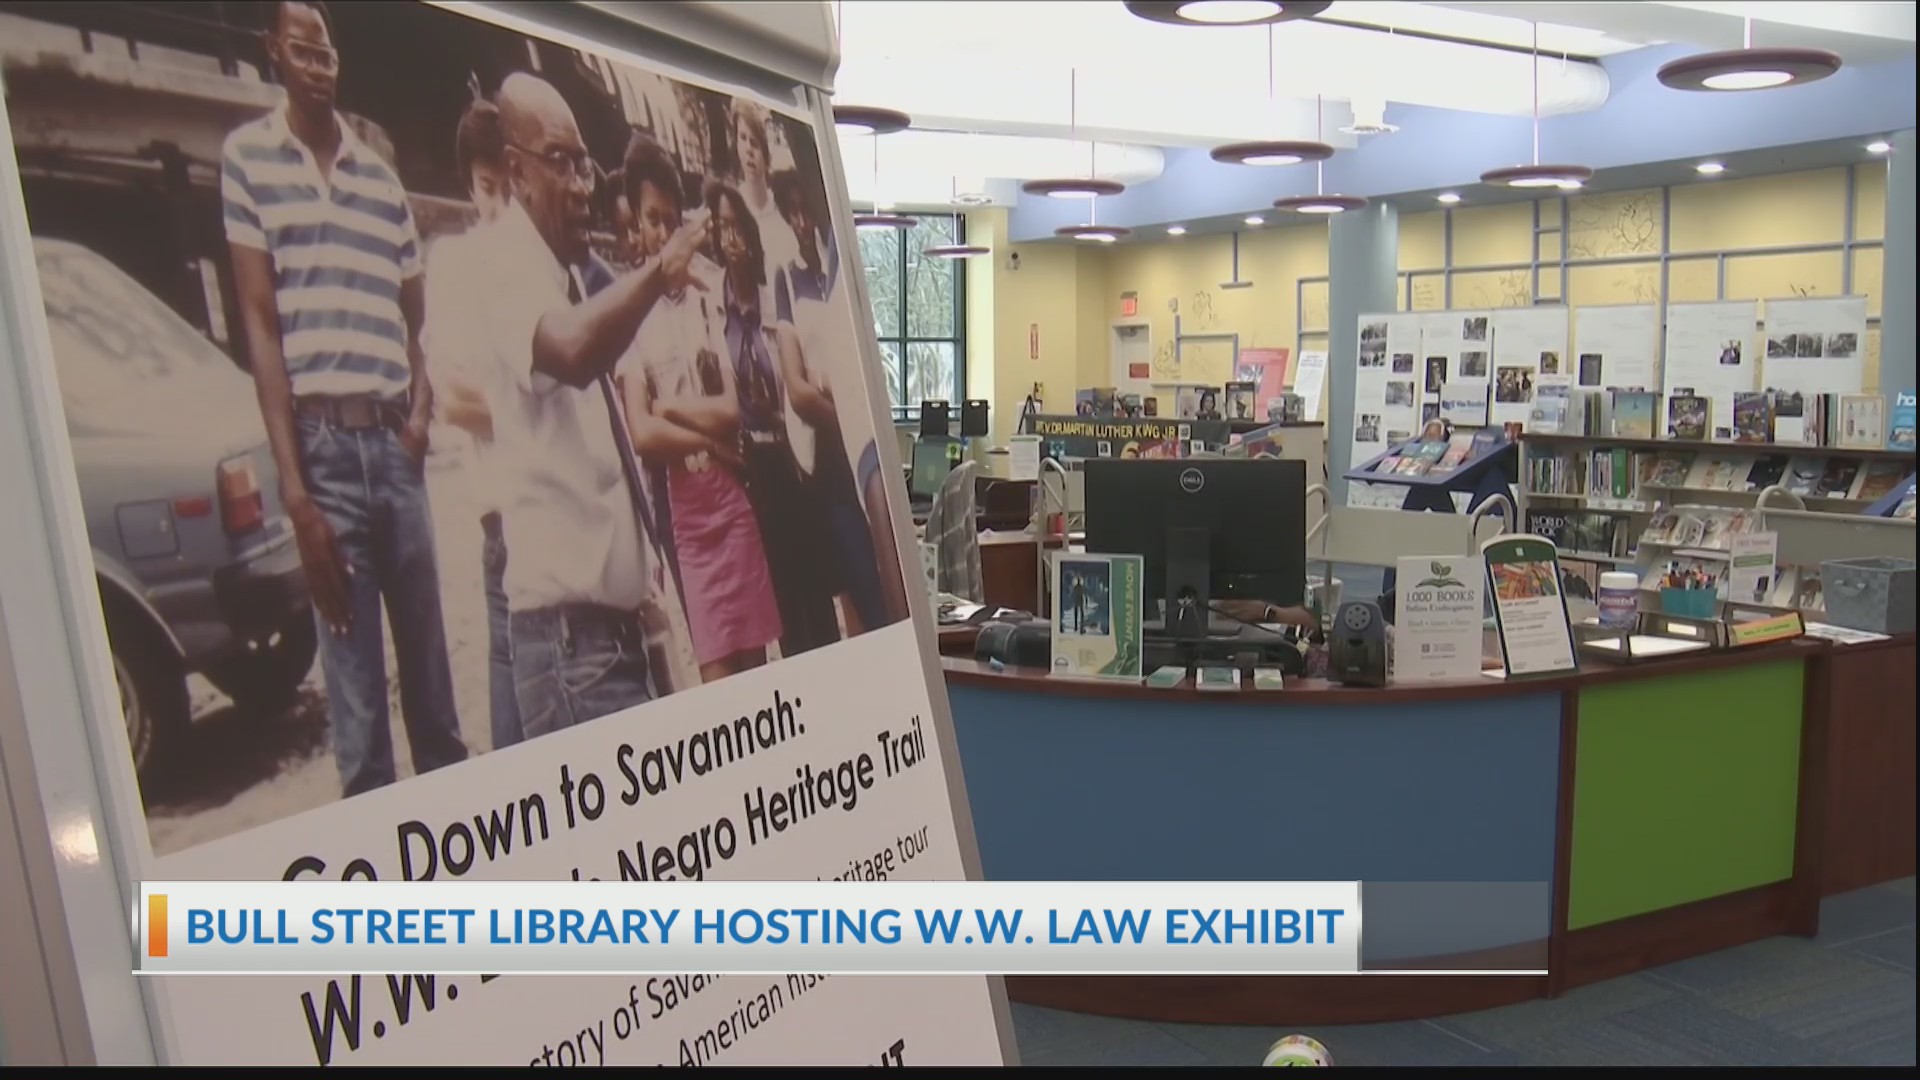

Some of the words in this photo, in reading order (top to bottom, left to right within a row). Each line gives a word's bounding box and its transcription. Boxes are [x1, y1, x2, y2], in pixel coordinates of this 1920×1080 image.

[1096, 424, 1133, 438] LUTHER
[1531, 515, 1564, 528] WORLD
[1125, 562, 1134, 601] MOVIE
[1436, 590, 1475, 602] BOOKS
[1125, 603, 1134, 642] EVENT
[397, 793, 549, 881] Down
[559, 763, 606, 829] to
[616, 689, 806, 807] Savannah:
[616, 817, 737, 881] Negro
[743, 752, 875, 846] Heritage
[876, 714, 927, 778] Trail
[896, 825, 929, 864] tour
[613, 985, 639, 1040] of
[646, 974, 719, 1019] Sava
[679, 982, 784, 1067] American
